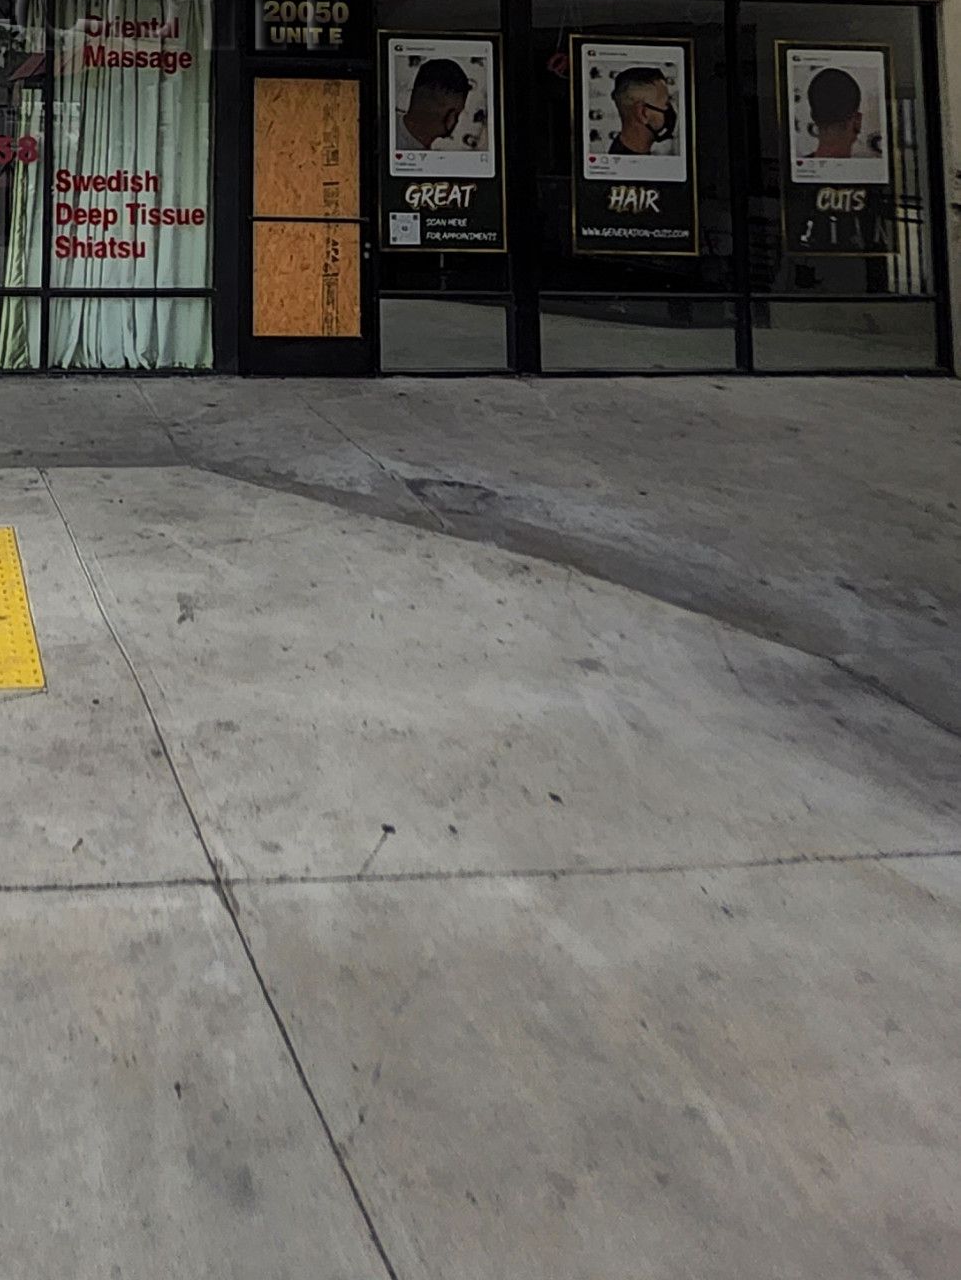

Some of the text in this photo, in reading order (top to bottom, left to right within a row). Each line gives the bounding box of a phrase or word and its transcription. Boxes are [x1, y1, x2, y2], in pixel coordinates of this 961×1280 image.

[263, 0, 350, 24] 20050
[85, 14, 179, 38] Oriental
[270, 26, 343, 45] UNIT E
[83, 44, 193, 75] Massage
[55, 169, 160, 193] Swedish
[405, 184, 478, 208] GREAT
[610, 187, 661, 213] HAIR
[816, 187, 867, 212] CUTS
[55, 202, 206, 231] Deep Tissue
[55, 234, 147, 260] Shiatsu
